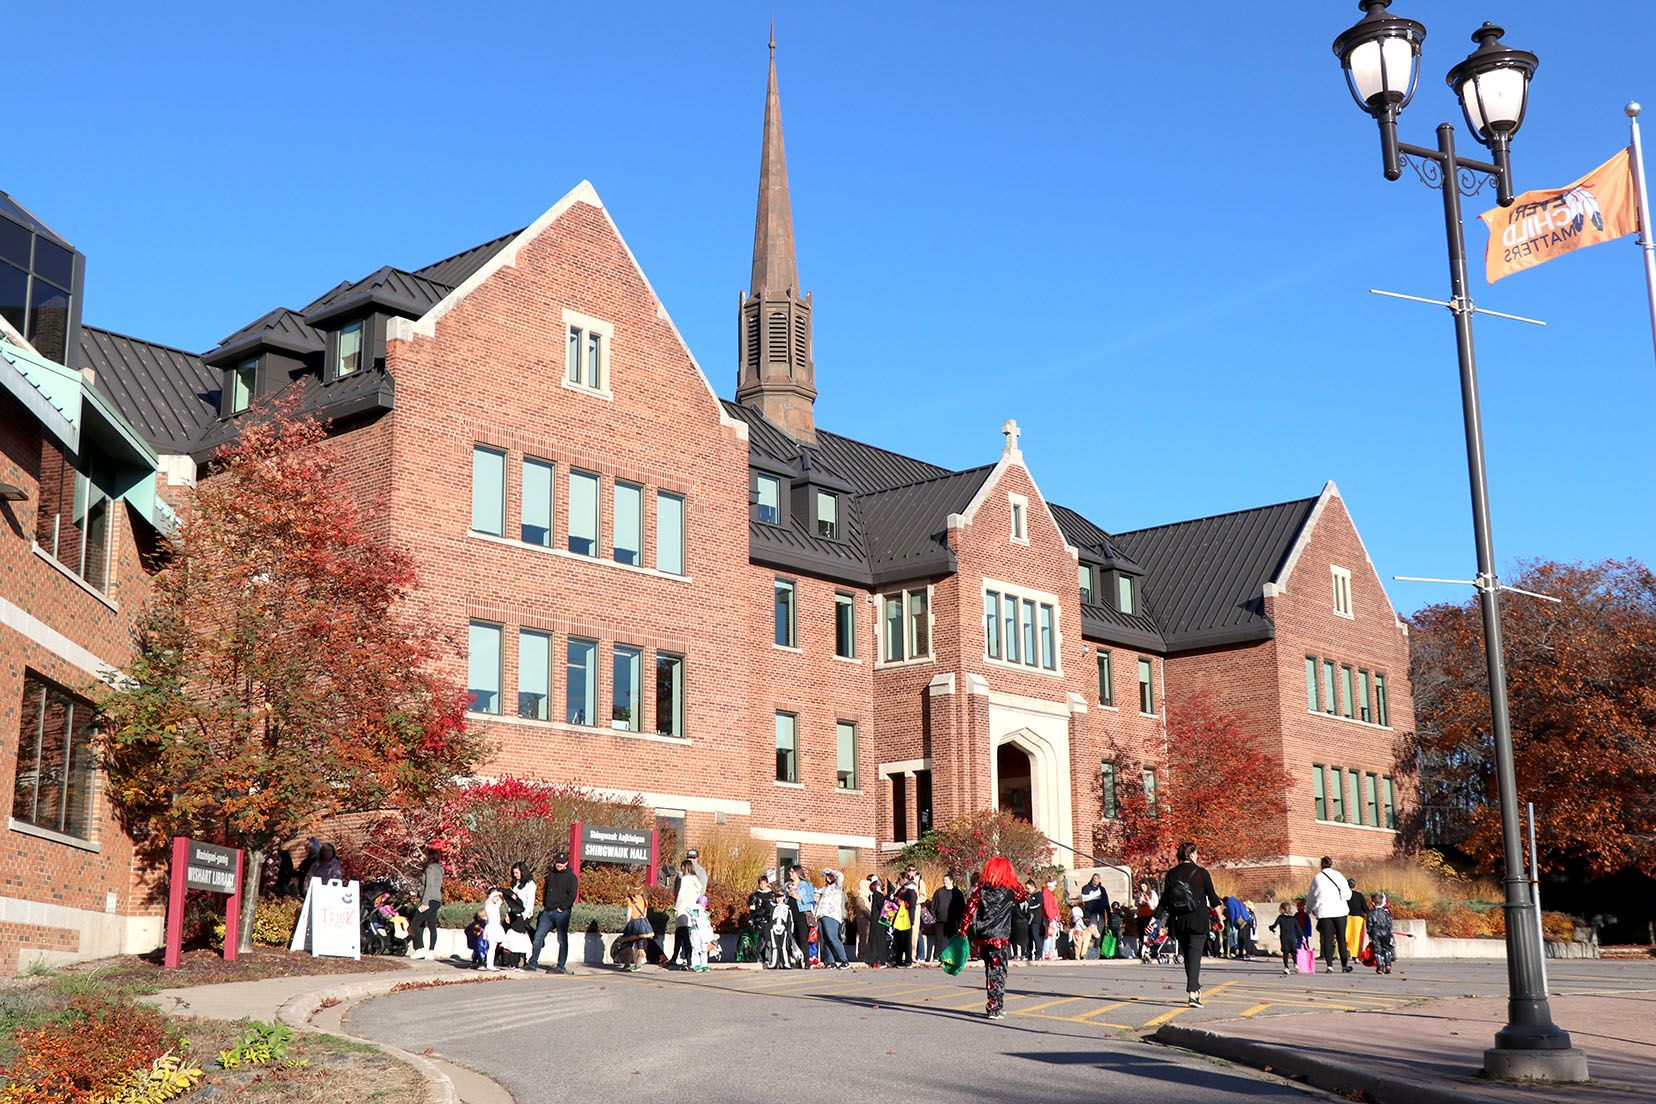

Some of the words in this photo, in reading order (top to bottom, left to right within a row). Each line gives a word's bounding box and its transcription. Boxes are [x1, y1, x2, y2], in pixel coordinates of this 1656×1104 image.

[585, 844, 628, 859] SHINGWAUK
[630, 848, 648, 860] HALL
[187, 866, 212, 884] WISHART
[212, 870, 235, 888] LIBRARY
